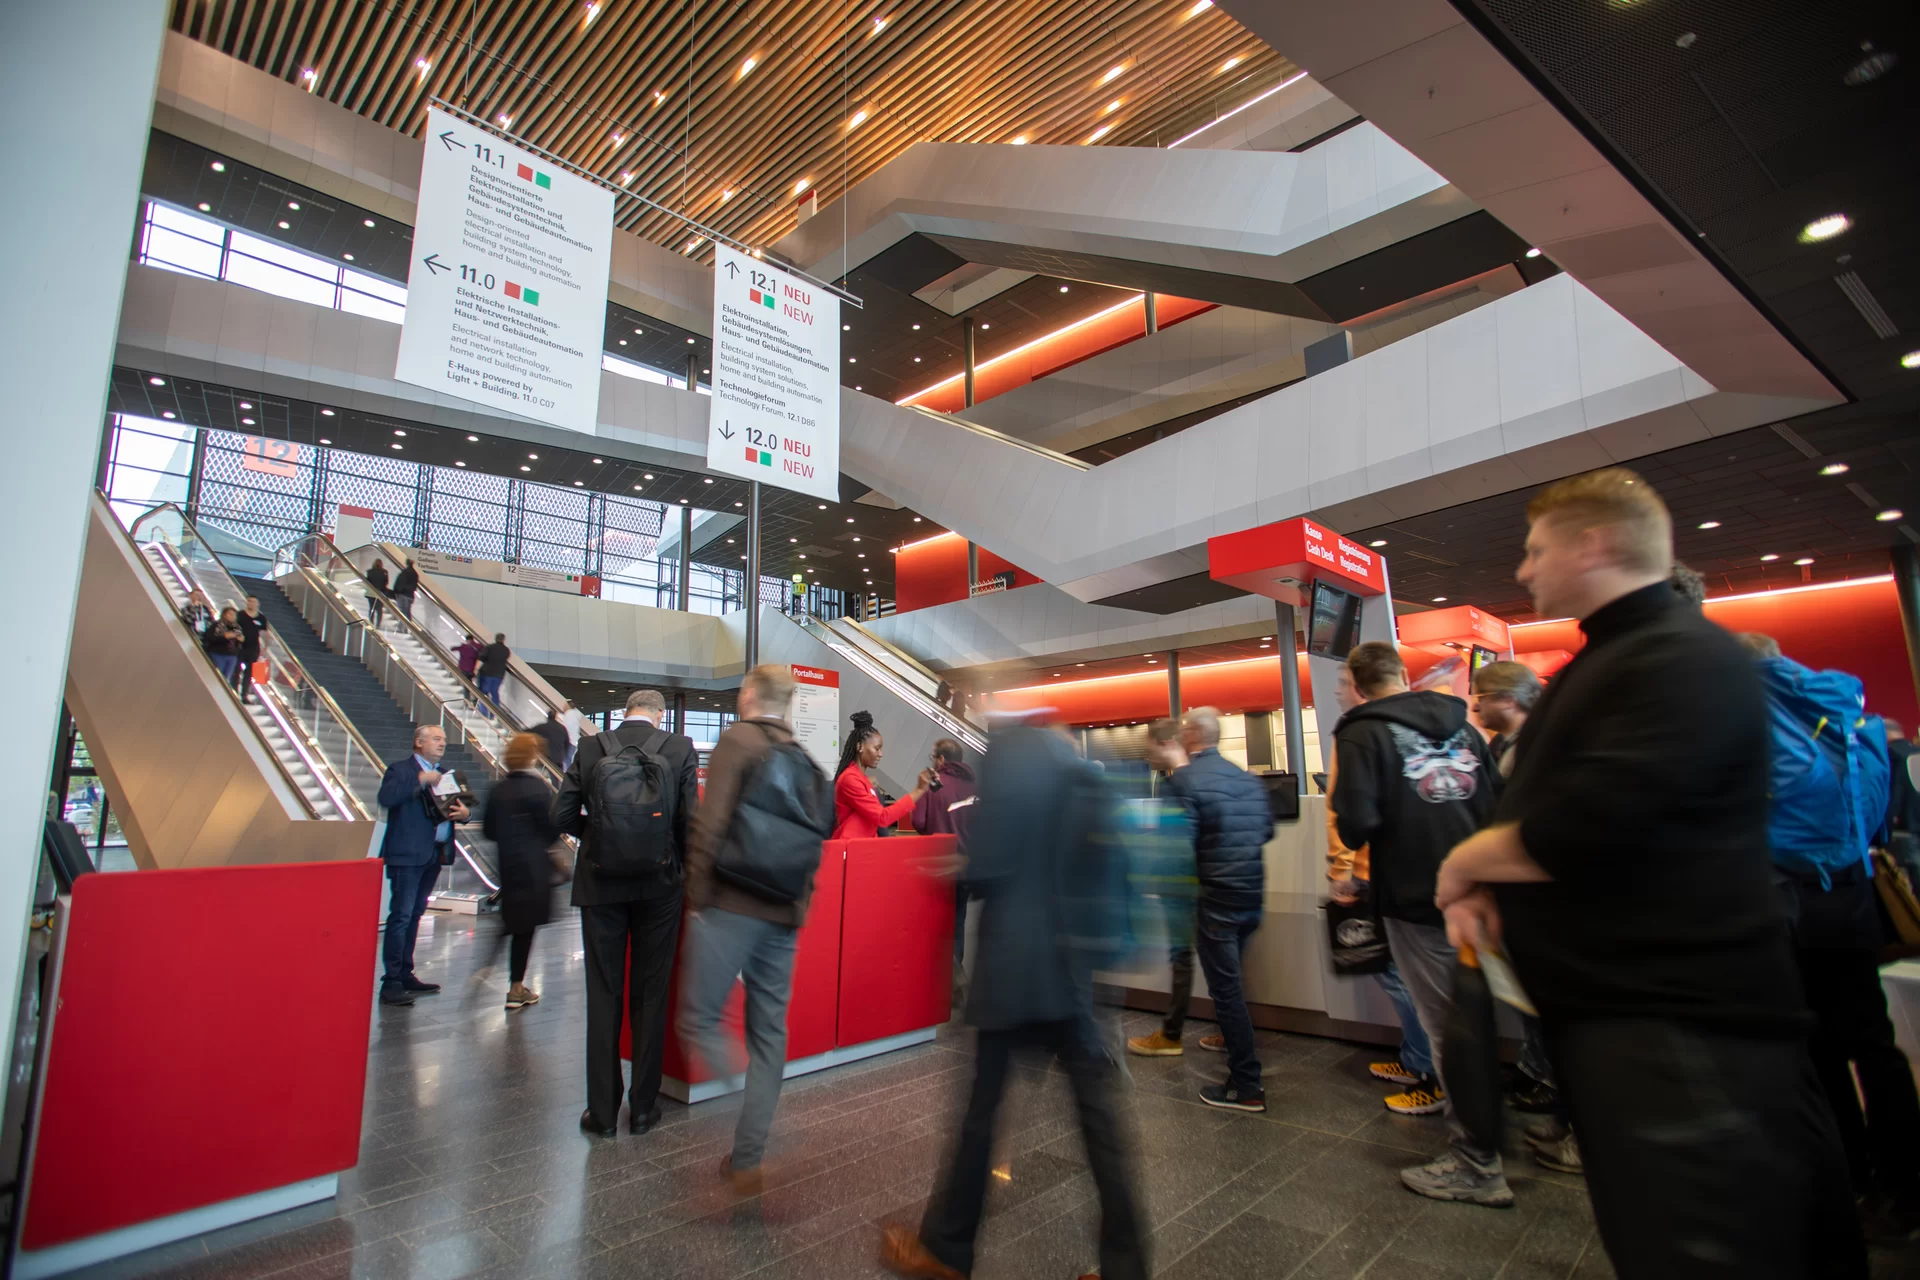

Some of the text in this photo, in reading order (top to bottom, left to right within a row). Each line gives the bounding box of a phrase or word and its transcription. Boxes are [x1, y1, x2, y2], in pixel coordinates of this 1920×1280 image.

[474, 144, 504, 169] 11.1
[470, 174, 563, 220] Elektroinstallation und
[471, 165, 543, 202] Designorientierte
[466, 208, 530, 240] Design-oriented
[468, 194, 593, 252] Haus- und Gebäudeautomation
[464, 219, 562, 264] electrical installation and
[464, 228, 497, 248] building
[499, 244, 527, 260] system
[460, 264, 495, 290] 11.0
[462, 238, 581, 290] home and building automation
[750, 270, 811, 306] 12.1 NEU
[456, 299, 549, 336] und Netzwerktechnik,
[457, 287, 560, 329] Elektrische Installations-
[722, 304, 790, 337] Elektroinstallation,
[784, 304, 814, 326] NEW
[451, 335, 468, 345] and
[470, 341, 504, 357] network
[452, 323, 537, 357] Electrical installation
[454, 308, 583, 358] Haus- und Gebäudeautomation
[722, 315, 813, 357] Gebäudesystemlösungen,
[722, 325, 830, 372] Haus- und Gebäudeautomation
[450, 344, 573, 389] home and building automation
[721, 341, 794, 374] Electrical installation,
[721, 352, 809, 390] building system solutions,
[447, 371, 470, 384] Light
[522, 393, 538, 404] 11.0
[540, 399, 555, 409] C07
[448, 360, 533, 393] E-Haus powered by
[720, 362, 823, 405] home and building automation
[720, 378, 786, 408] Technologieforum
[719, 390, 816, 427] Technology Forum, 12.1 D86
[253, 437, 291, 468] 12
[746, 427, 811, 458] 12.0 NEU
[784, 459, 815, 479] NEW
[1305, 522, 1323, 541] Kasse
[1306, 540, 1335, 563] Cash Desk
[1340, 555, 1368, 577] Registration
[508, 565, 516, 573] 12
[793, 668, 824, 680] Portalhaus
